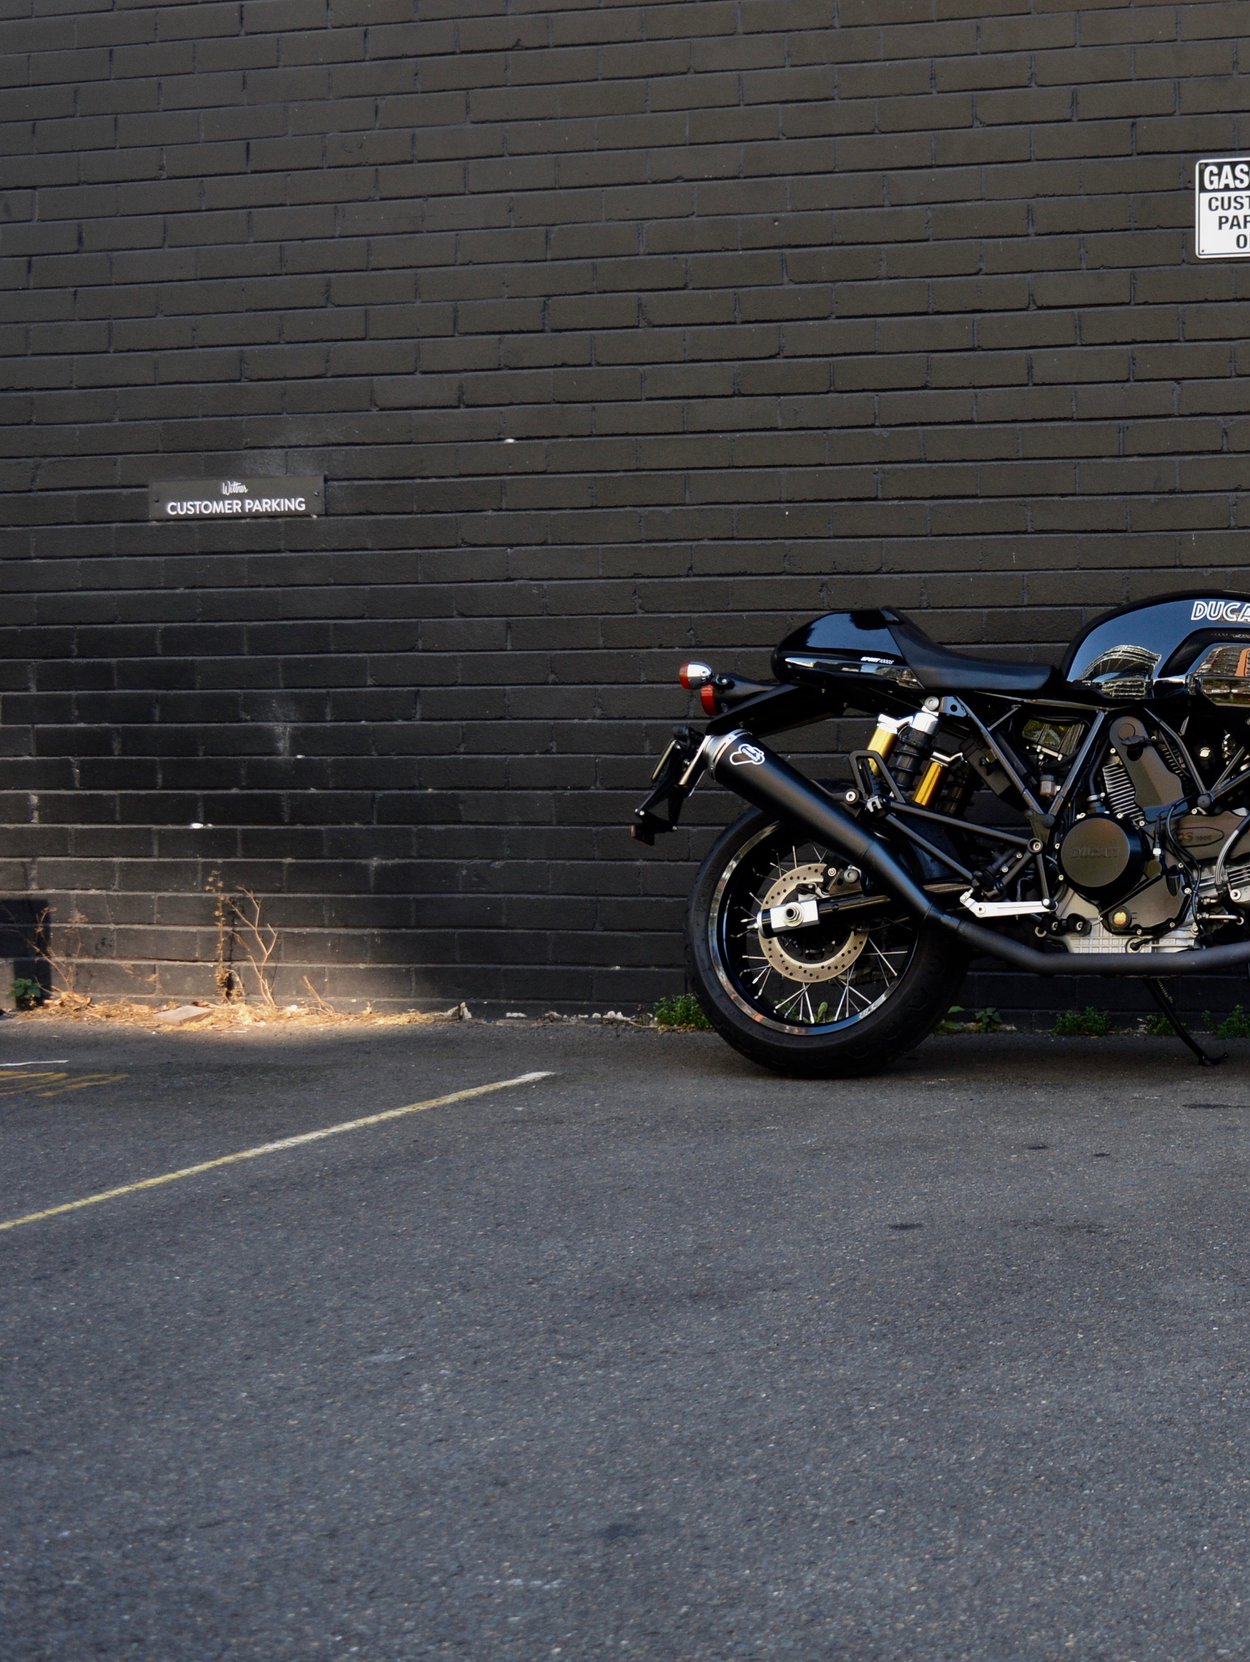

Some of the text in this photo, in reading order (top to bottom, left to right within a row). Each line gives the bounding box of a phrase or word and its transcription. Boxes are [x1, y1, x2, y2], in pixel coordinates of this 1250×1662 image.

[167, 498, 306, 515] CUSTOMER PARKING
[1071, 847, 1121, 858] DUCATI
